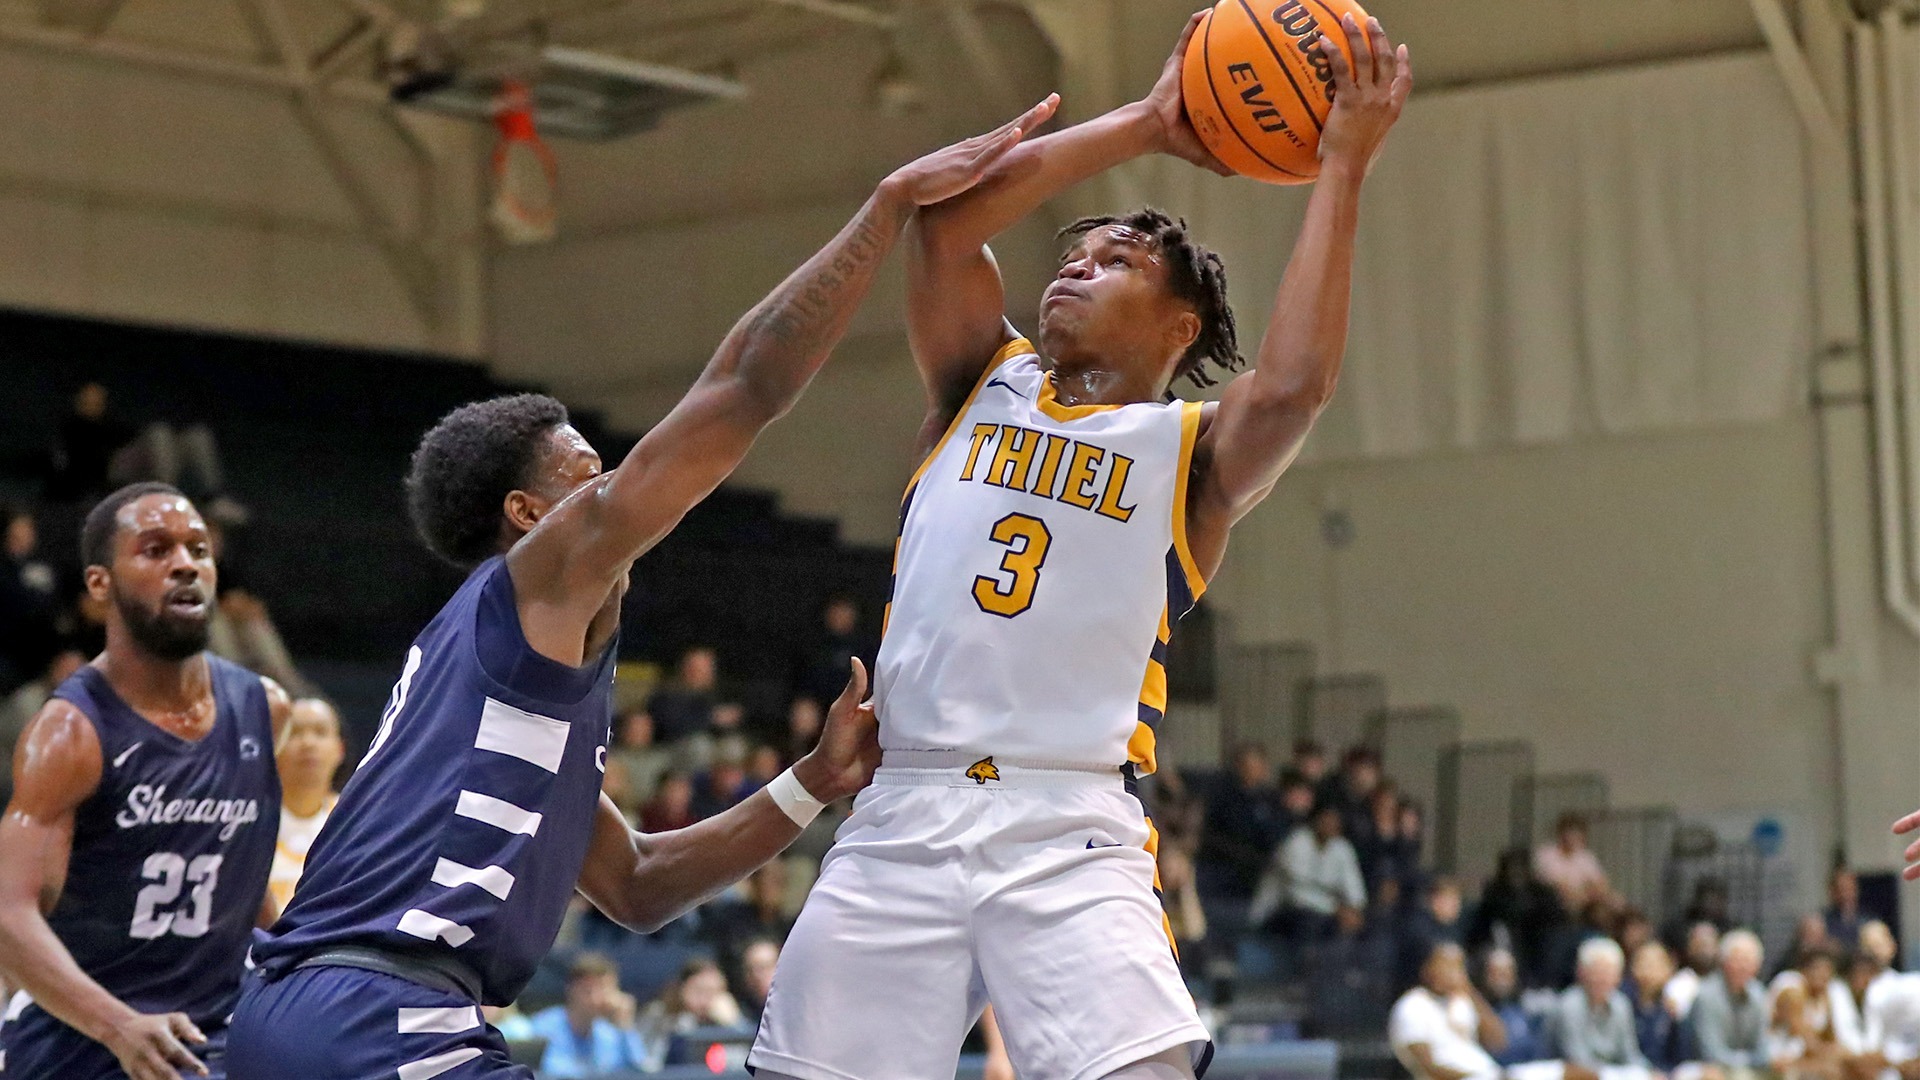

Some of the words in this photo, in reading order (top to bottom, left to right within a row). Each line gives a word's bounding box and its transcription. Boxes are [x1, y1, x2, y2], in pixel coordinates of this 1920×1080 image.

[1227, 61, 1288, 133] EVO
[1283, 130, 1306, 149] NXT
[959, 422, 1138, 524] THIEL
[971, 511, 1053, 619] 3
[115, 784, 260, 841] Shenango
[129, 852, 224, 940] 23
